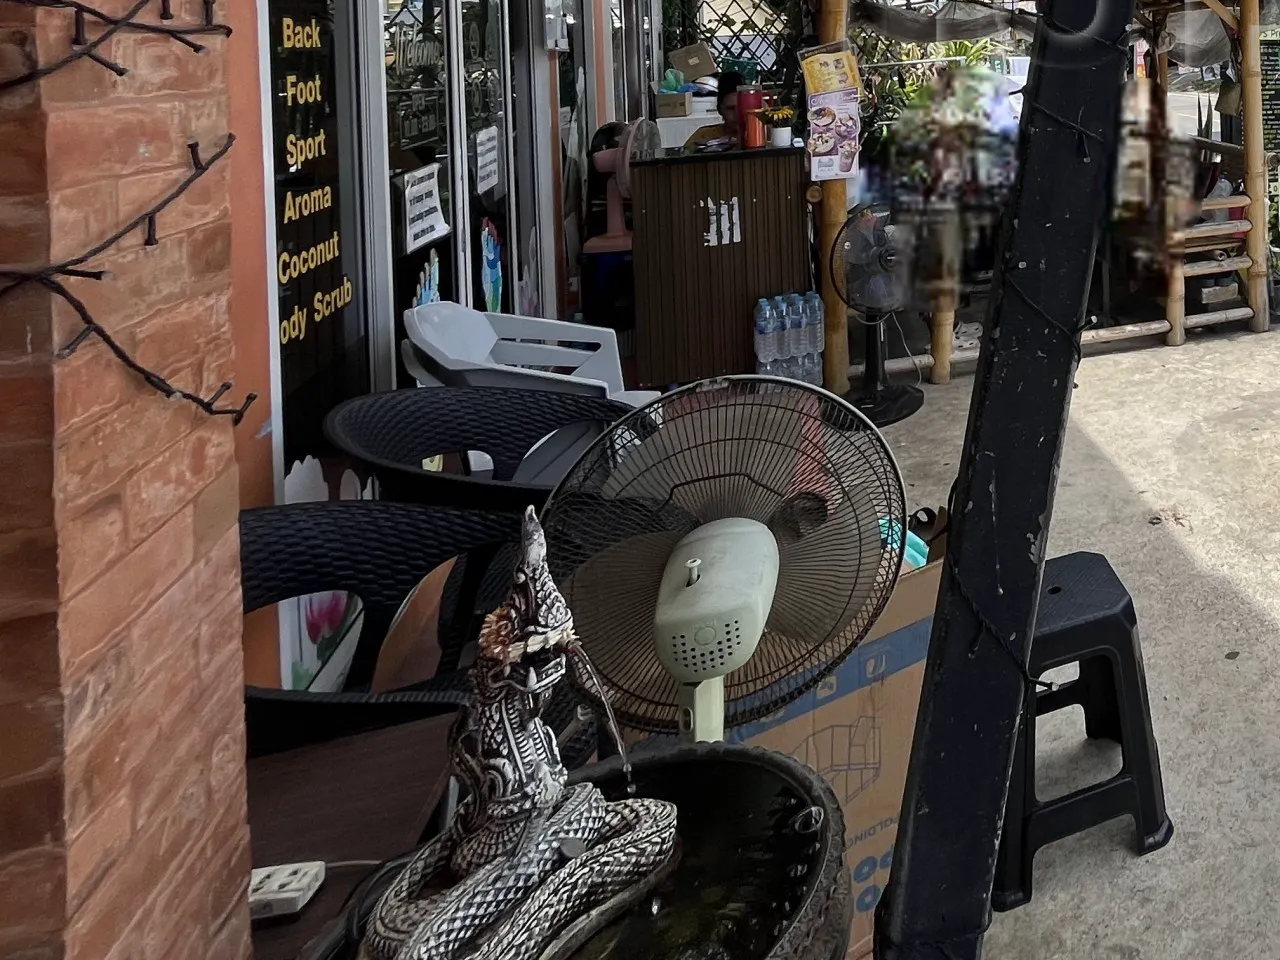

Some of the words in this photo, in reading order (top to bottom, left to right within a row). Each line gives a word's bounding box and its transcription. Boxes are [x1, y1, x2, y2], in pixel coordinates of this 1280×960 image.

[283, 16, 322, 51] Back
[286, 74, 322, 106] Foot
[286, 128, 327, 170] Sport
[283, 185, 332, 225] Aroma
[278, 231, 340, 284] Coconut
[281, 308, 307, 345] ody
[313, 276, 353, 323] Scrub
